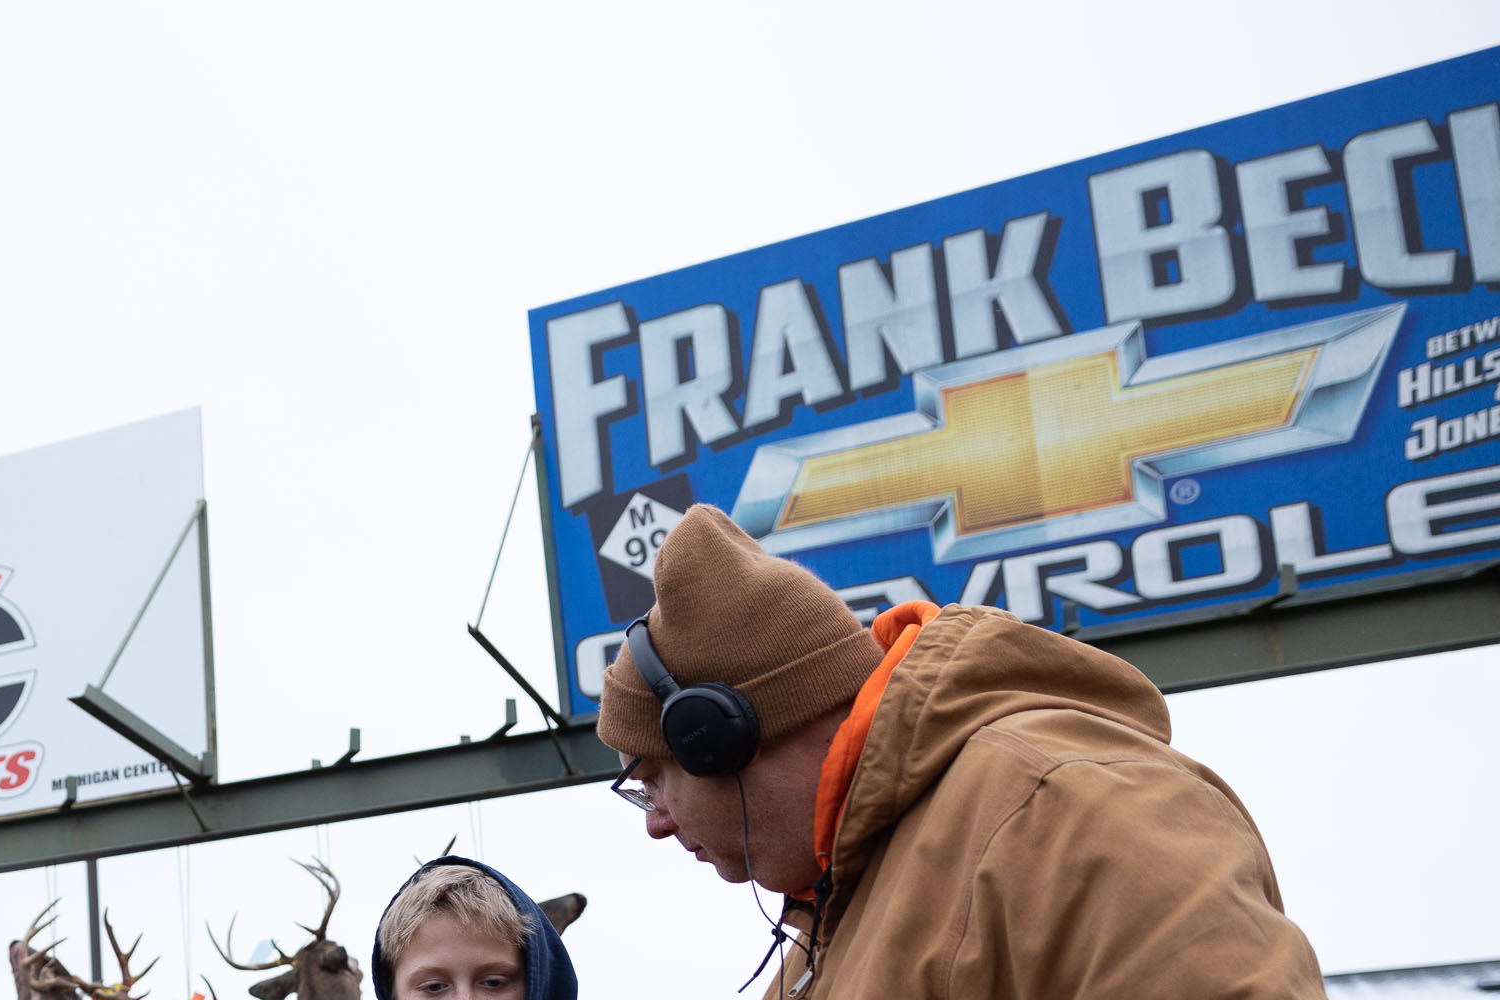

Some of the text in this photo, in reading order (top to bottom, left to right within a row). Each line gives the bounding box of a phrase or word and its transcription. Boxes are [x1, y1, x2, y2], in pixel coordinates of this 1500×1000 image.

[546, 210, 1063, 509] FRANK
[629, 502, 655, 529] M
[51, 759, 171, 790] MIHIGAN CENTE
